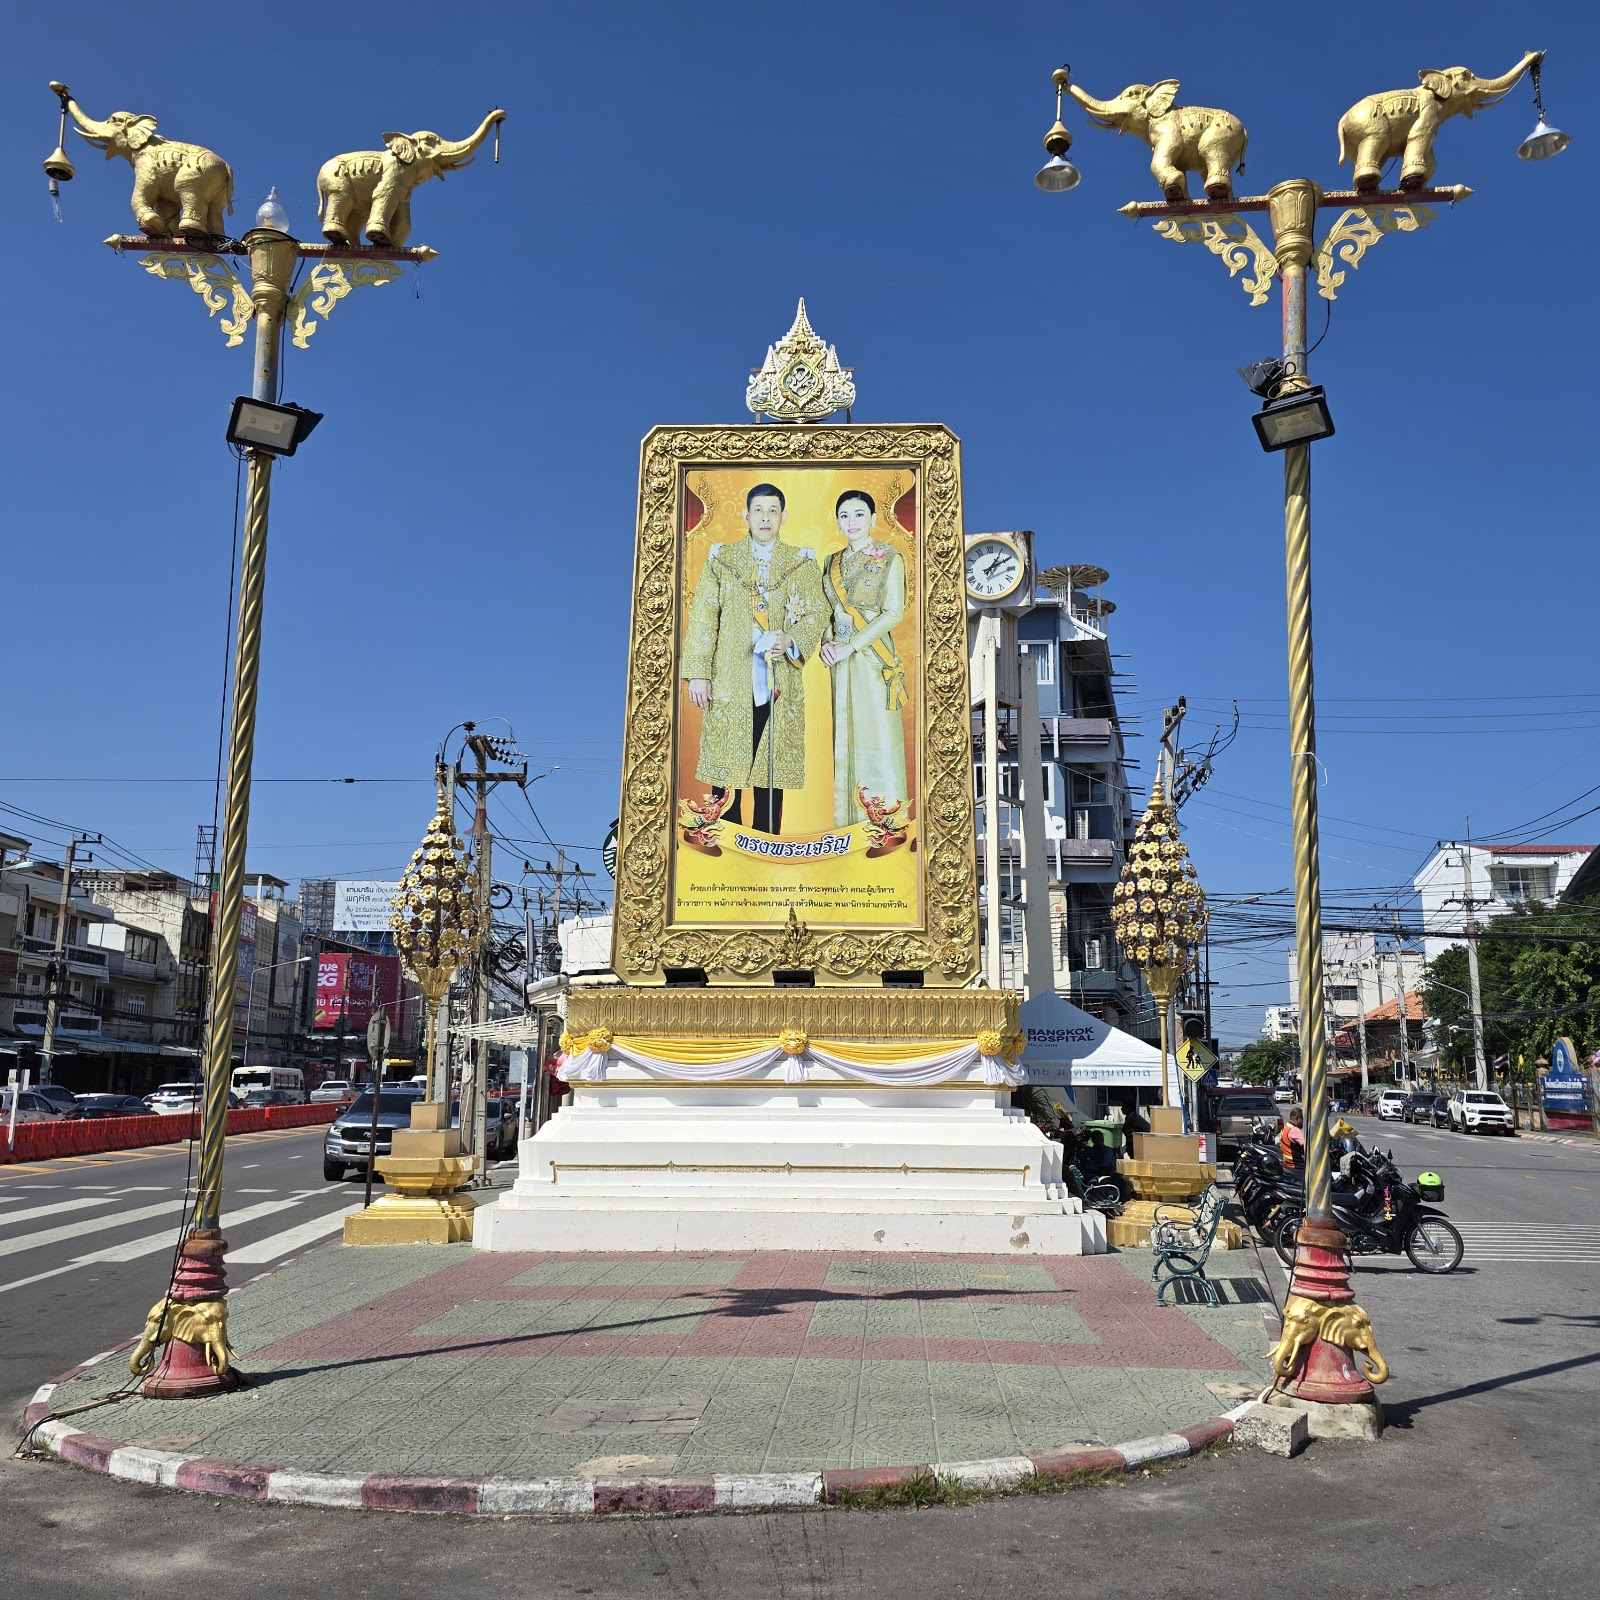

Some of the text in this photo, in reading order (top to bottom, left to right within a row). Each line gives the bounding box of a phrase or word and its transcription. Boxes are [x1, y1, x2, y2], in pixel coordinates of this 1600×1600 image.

[735, 833, 852, 857] ทรงพระเจริญ
[799, 884, 848, 895] ข้าพระพุทธเจ้า
[850, 885, 895, 896] คณะผู้บริหาร
[677, 898, 712, 906] ข้าราชการ
[319, 963, 339, 971] rue
[1027, 1026, 1094, 1036] BANGKOK
[1027, 1034, 1095, 1043] HOSPITAL
[1057, 1067, 1151, 1080] มาตรฐานสากล
